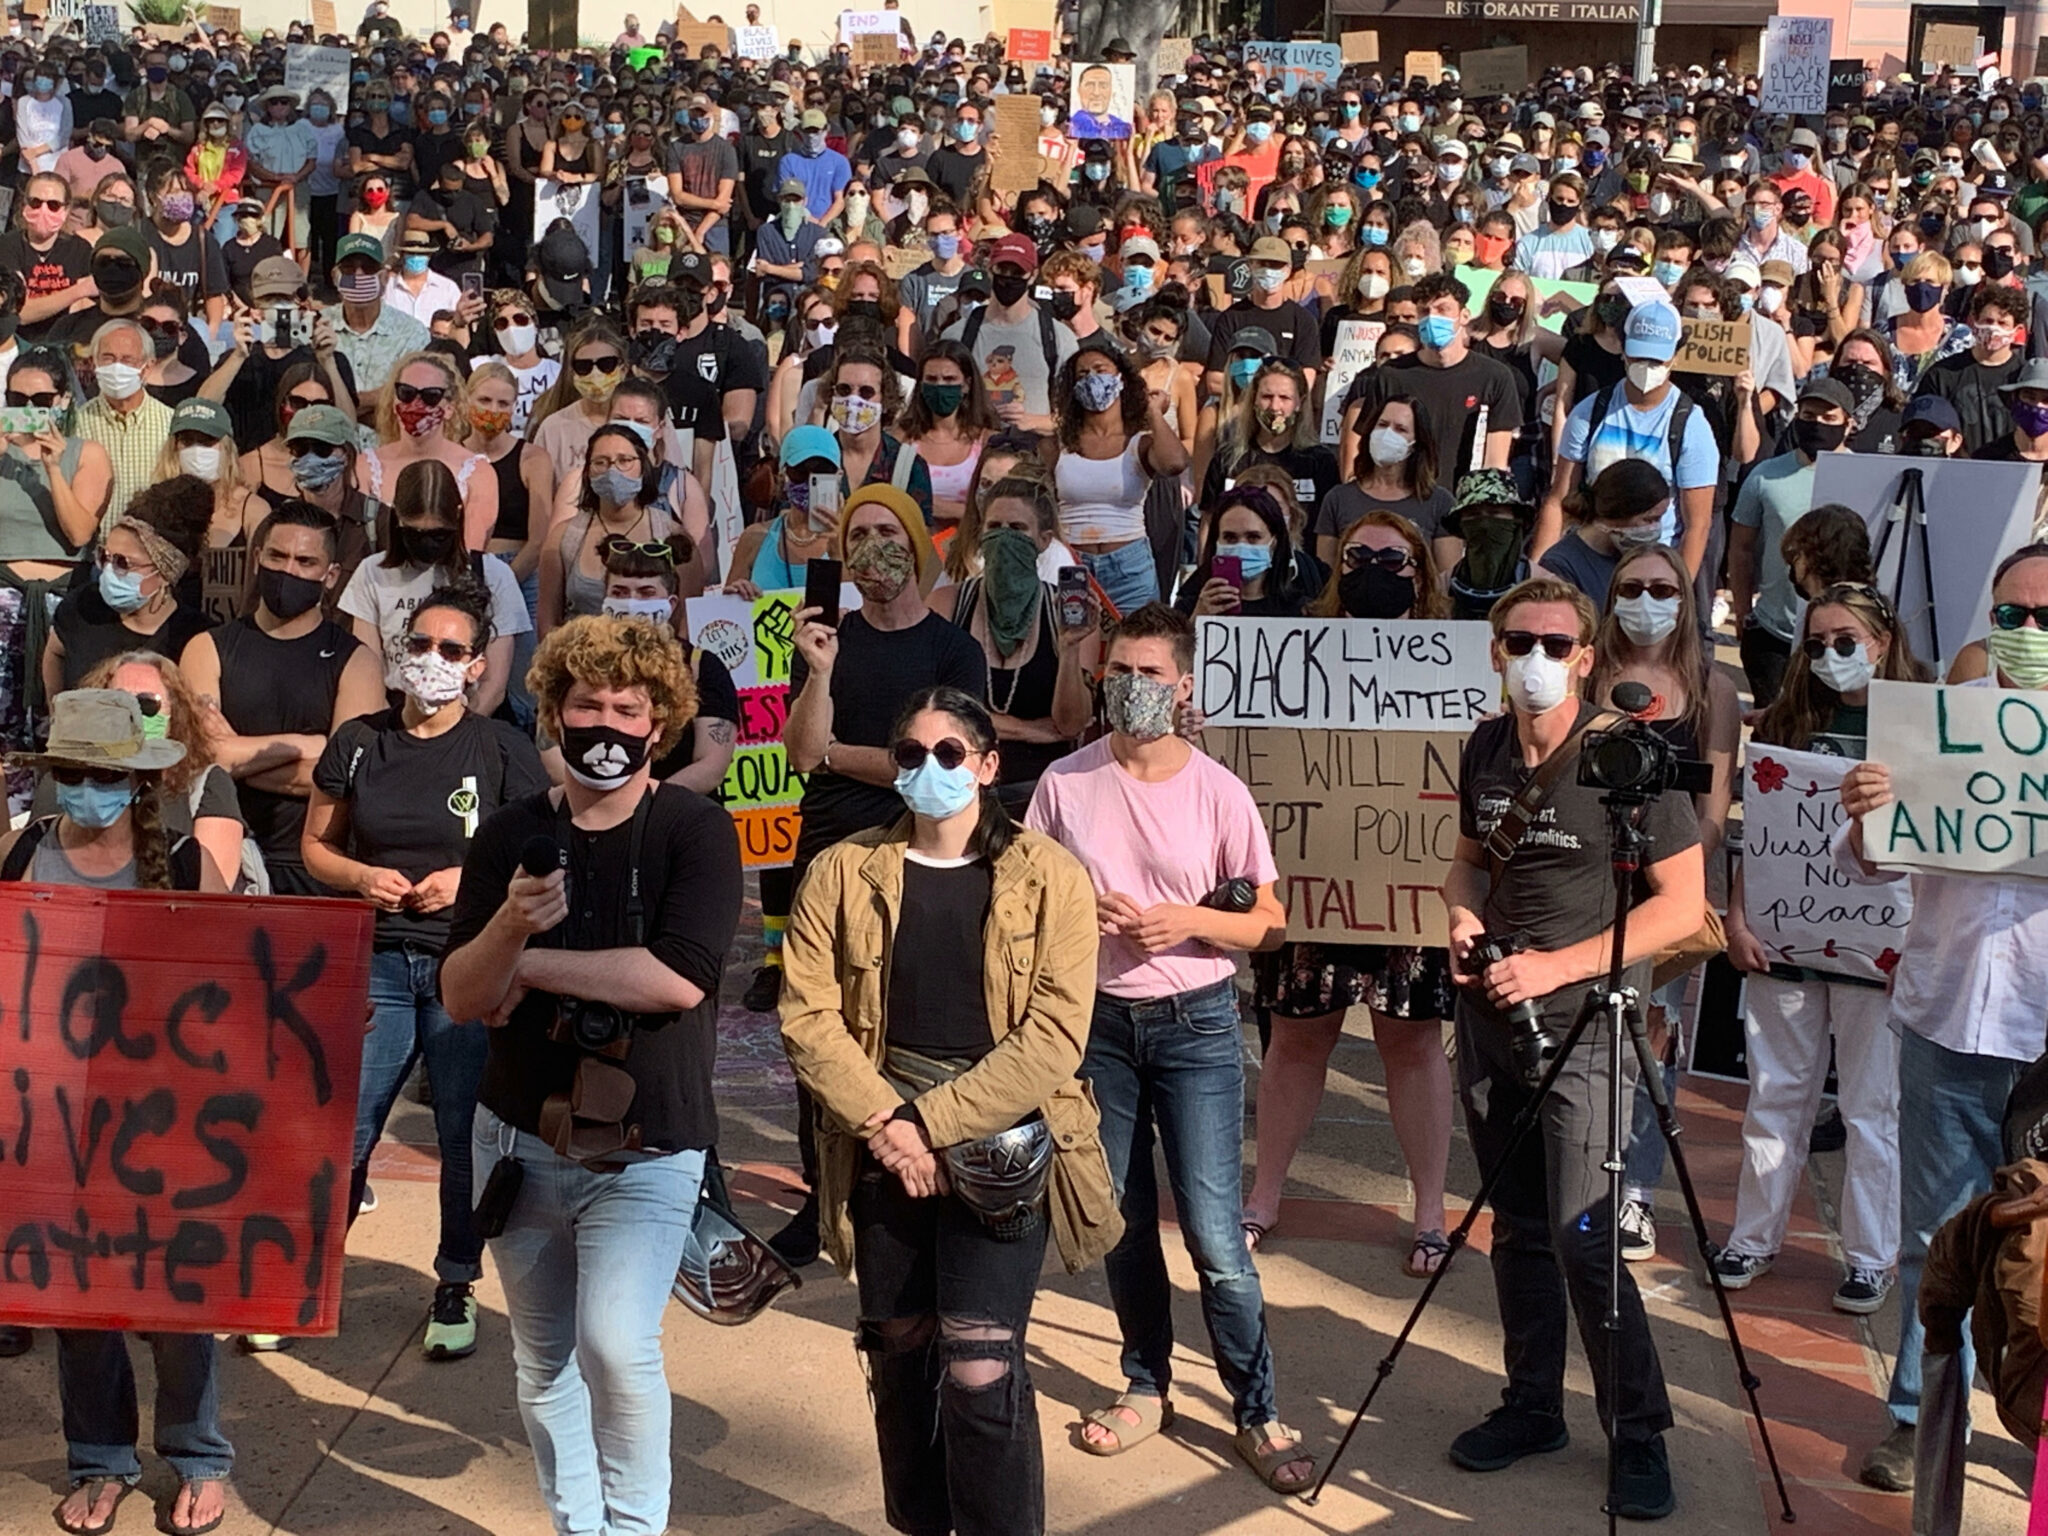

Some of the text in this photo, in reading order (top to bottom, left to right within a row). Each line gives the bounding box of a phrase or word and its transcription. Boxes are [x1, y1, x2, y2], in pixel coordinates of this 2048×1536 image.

[1445, 1, 1560, 18] RISTORANTE
[848, 14, 880, 27] END
[1779, 18, 1828, 35] AMERICA
[743, 27, 772, 38] BLACK
[743, 37, 773, 47] LIVES
[741, 46, 778, 58] MATTER
[1247, 45, 1335, 68] BLACK LIVES
[1770, 63, 1826, 81] BLACK
[1771, 79, 1823, 94] LIVES
[1761, 94, 1825, 114] MATTER
[1337, 371, 1349, 383] IS
[717, 642, 743, 661] HIS
[1202, 620, 1453, 720] BLACK Lives
[1348, 673, 1489, 724] MATTER
[1297, 728, 1405, 792] WILL
[733, 811, 803, 857] US
[1354, 804, 1455, 864] POLIC
[1888, 799, 2048, 859] ANOT
[1284, 874, 1448, 935] TALIT
[1757, 895, 1912, 933] peace
[0, 1066, 266, 1210] ives
